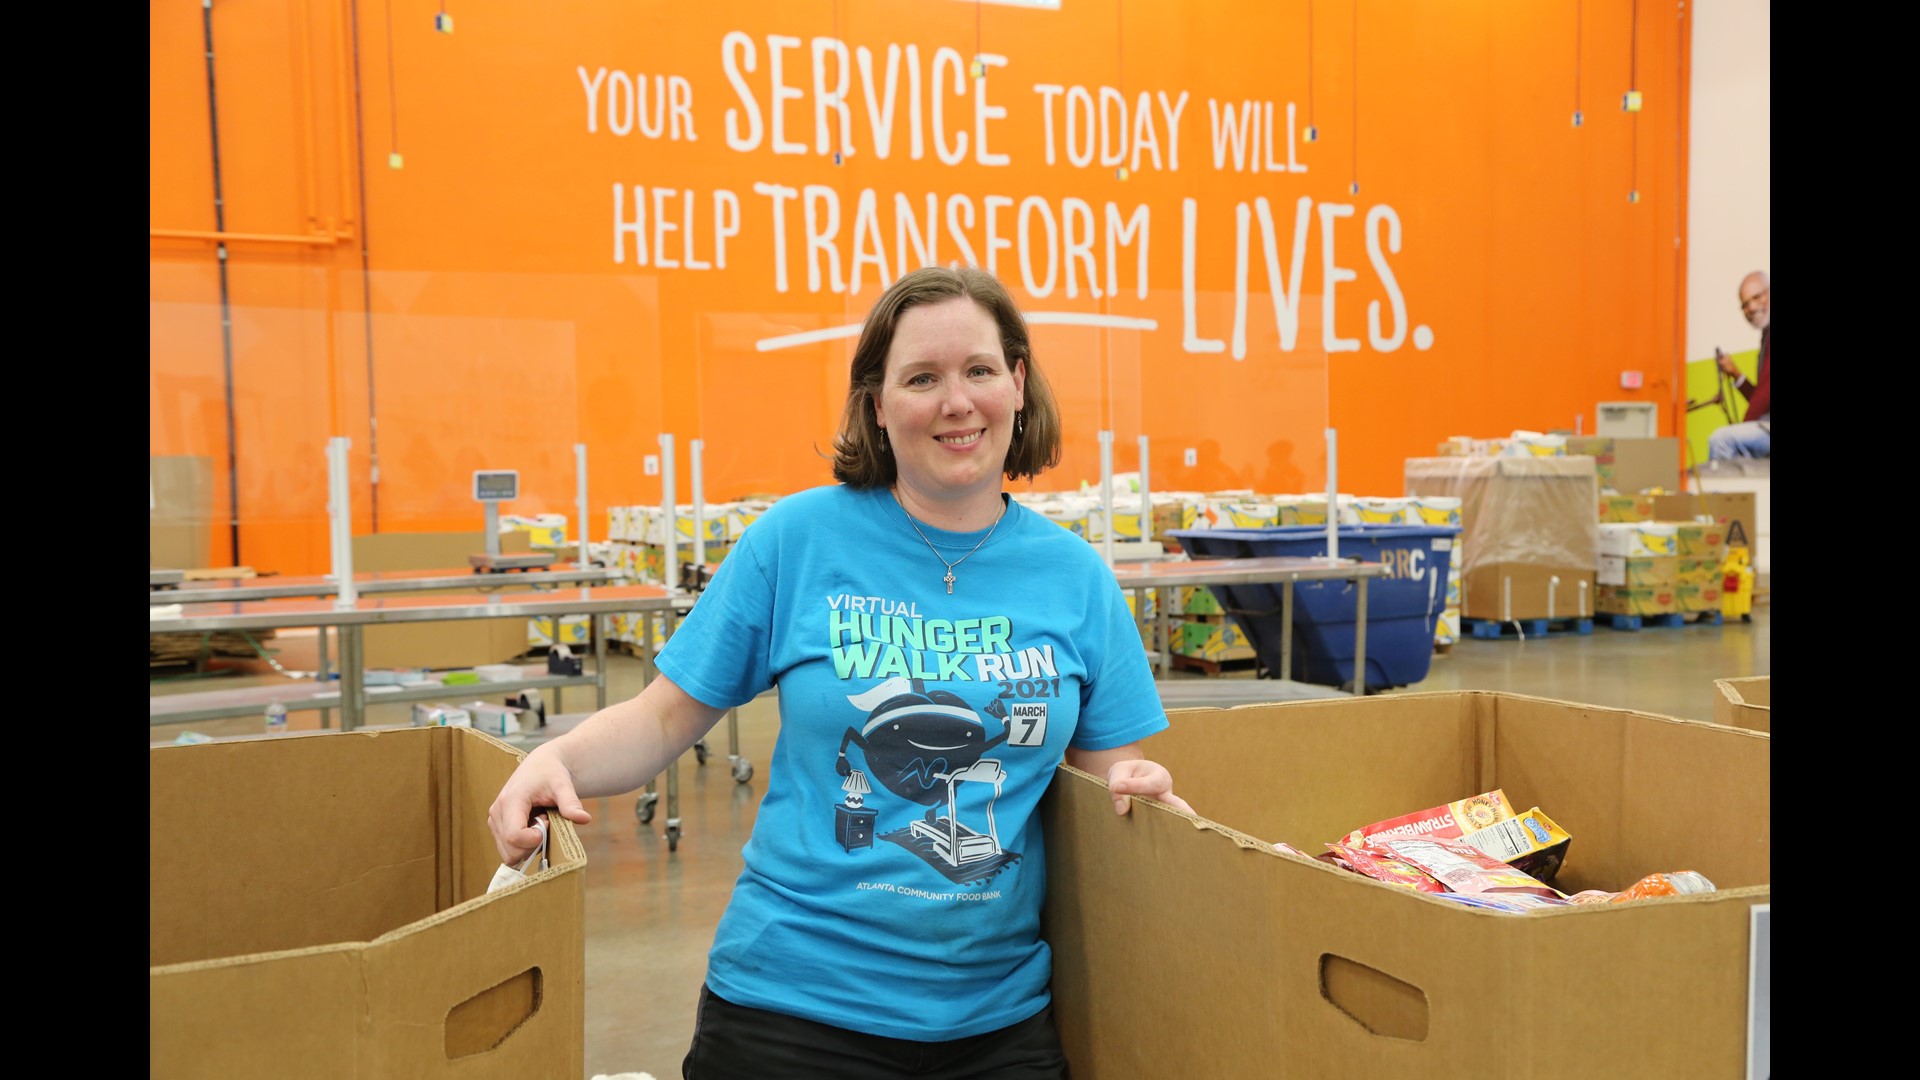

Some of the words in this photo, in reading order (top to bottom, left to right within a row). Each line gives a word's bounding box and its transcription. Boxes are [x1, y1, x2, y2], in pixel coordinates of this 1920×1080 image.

[577, 66, 698, 141] YOUR
[721, 31, 1010, 166] SERVICE
[1033, 83, 1189, 171] TODAY
[1208, 98, 1308, 174] WILL
[613, 182, 741, 270] HELP
[754, 182, 1150, 299] TRANSFORM
[1182, 197, 1434, 360] LIVES.
[827, 594, 923, 618] VIRTUAL
[829, 610, 1015, 654] HUNGER
[832, 642, 973, 681] WALK
[975, 644, 1059, 682] RUN
[997, 678, 1060, 699] 2021
[1013, 706, 1046, 717] MARCH
[1019, 718, 1038, 744] 7
[856, 882, 895, 892] ATLANTA
[897, 886, 954, 901] COMMUNITY
[956, 893, 981, 901] FOOD
[982, 890, 1001, 901] BANK
